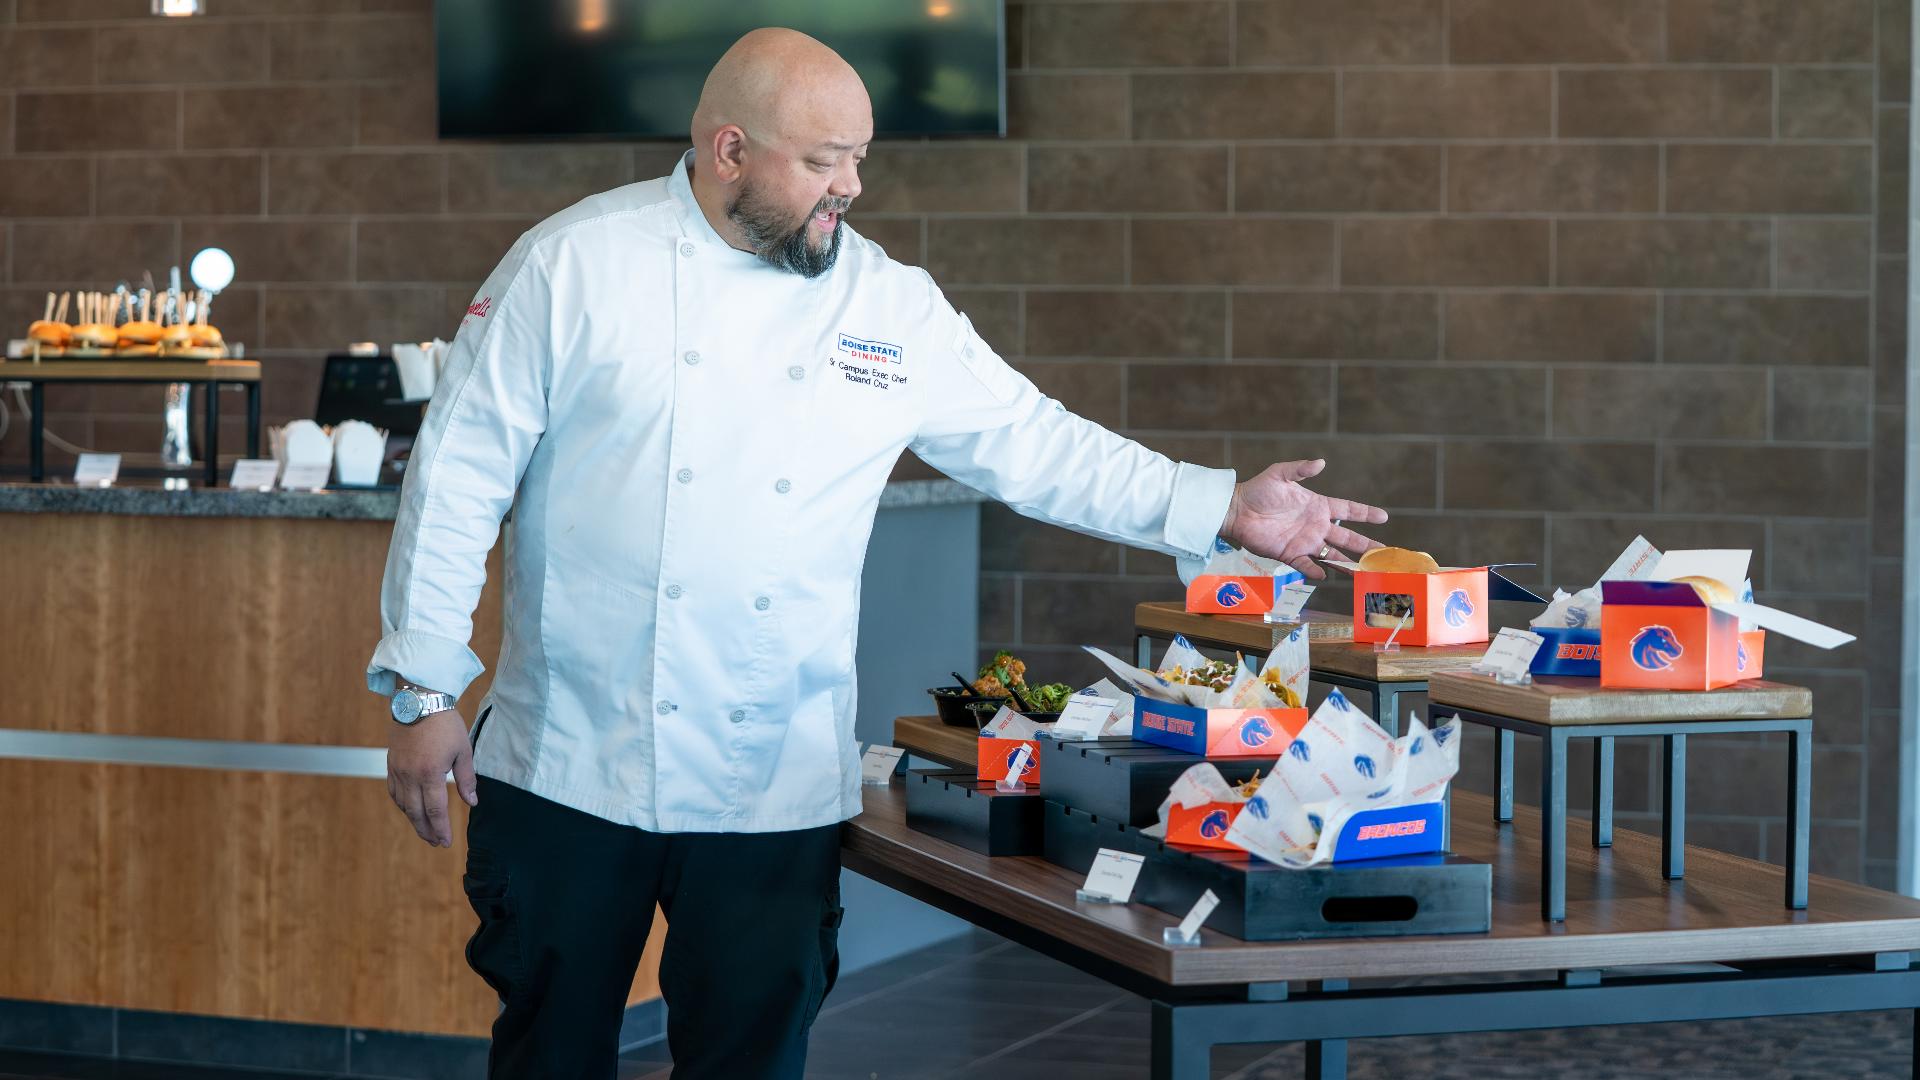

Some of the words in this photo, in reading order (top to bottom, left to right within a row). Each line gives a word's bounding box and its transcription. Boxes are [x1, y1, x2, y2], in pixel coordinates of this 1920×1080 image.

[841, 338, 868, 352] BOISE
[870, 345, 898, 358] STATE
[851, 350, 887, 363] DINING
[838, 361, 869, 375] Campus
[872, 368, 889, 380] Exec
[891, 373, 908, 384] Chef
[845, 372, 871, 385] Roland
[873, 379, 889, 390] Cruz
[1356, 818, 1427, 841] BRONCOS
